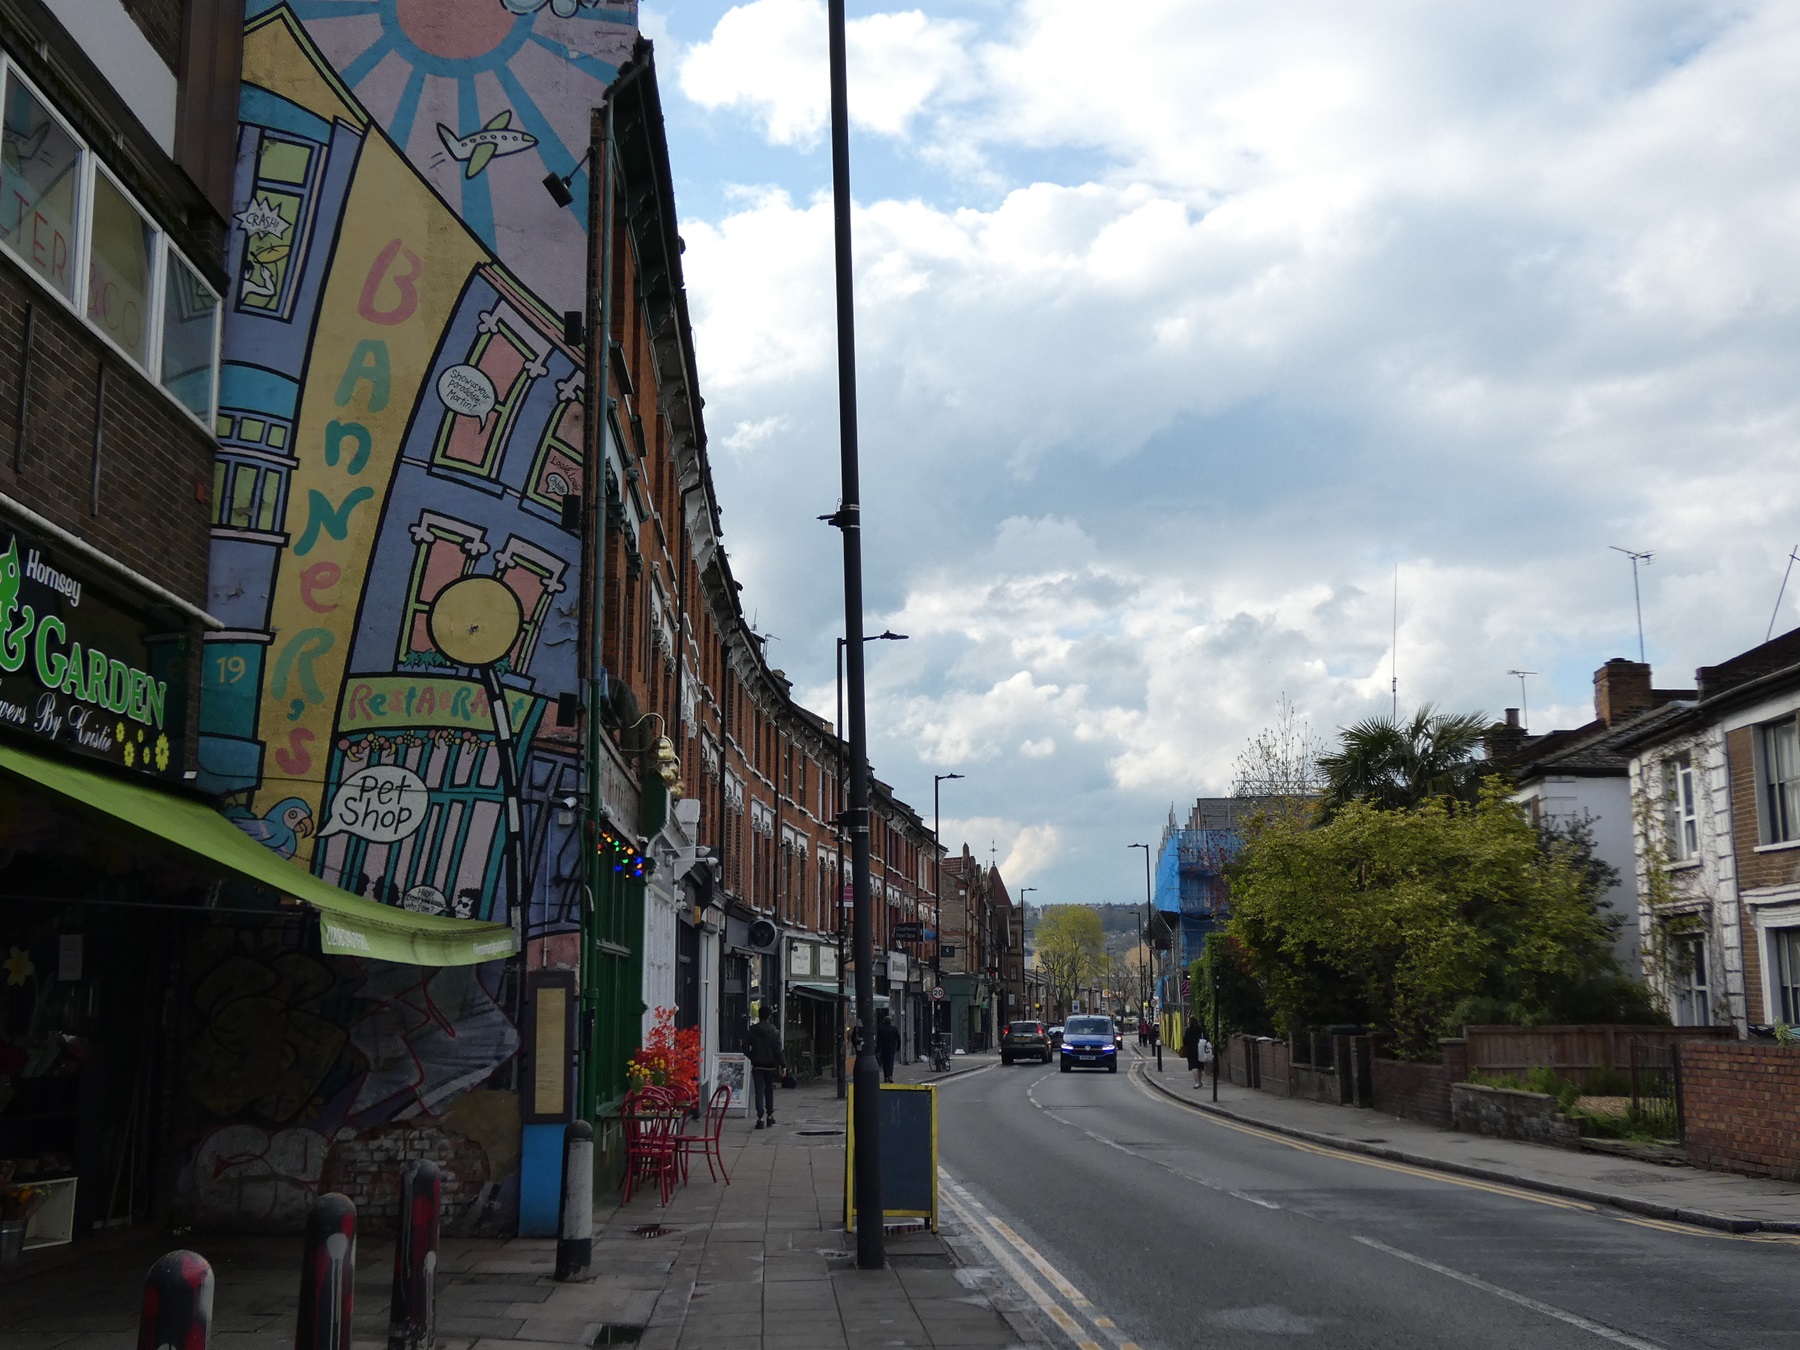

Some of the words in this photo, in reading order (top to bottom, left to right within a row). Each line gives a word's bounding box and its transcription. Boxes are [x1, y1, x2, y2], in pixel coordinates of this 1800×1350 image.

[246, 212, 280, 232] CRASH!
[446, 388, 477, 411] Martin!
[450, 369, 472, 385] Show
[471, 381, 479, 389] us
[475, 385, 492, 400] your
[26, 548, 82, 607] Hornsey
[35, 615, 167, 730] GARDEN
[216, 656, 246, 685] 19
[34, 691, 63, 740] By
[68, 704, 113, 752] Kristie
[358, 773, 413, 806] Pet
[338, 796, 414, 832] Shop
